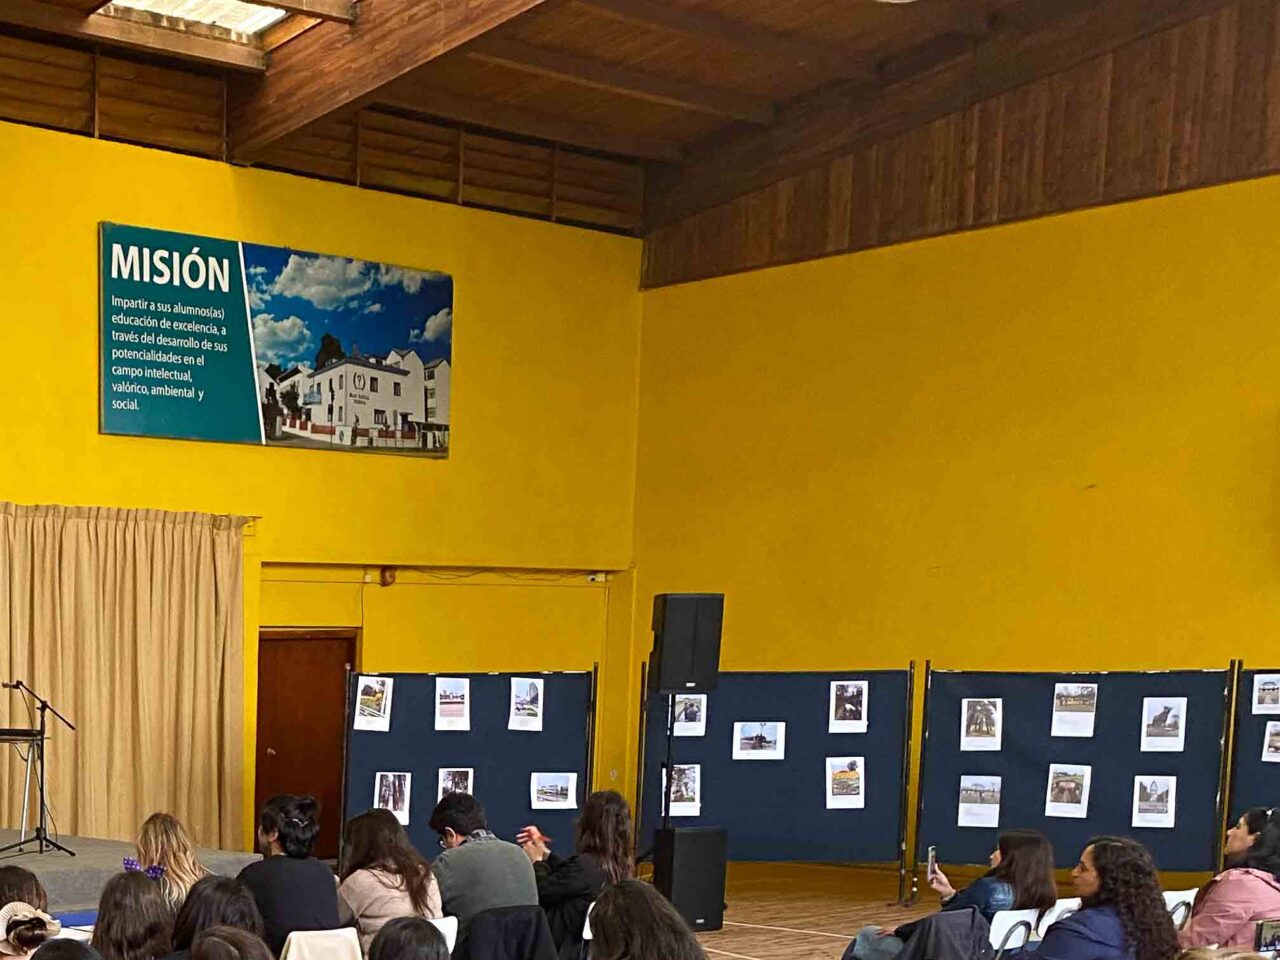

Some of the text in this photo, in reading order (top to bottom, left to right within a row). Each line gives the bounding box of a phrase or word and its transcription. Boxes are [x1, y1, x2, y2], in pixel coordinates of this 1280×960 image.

[111, 243, 230, 293] MISIÓN
[111, 294, 225, 320] Impartir a sus alumnos(as)
[111, 312, 227, 336] educación de excelencia, a
[111, 329, 228, 352] través del desarrollo de sus
[111, 347, 205, 366] potencialidades en el
[111, 365, 193, 382] campo intelectual,
[111, 381, 204, 402] valórico, ambiental y
[111, 398, 140, 411] social.
